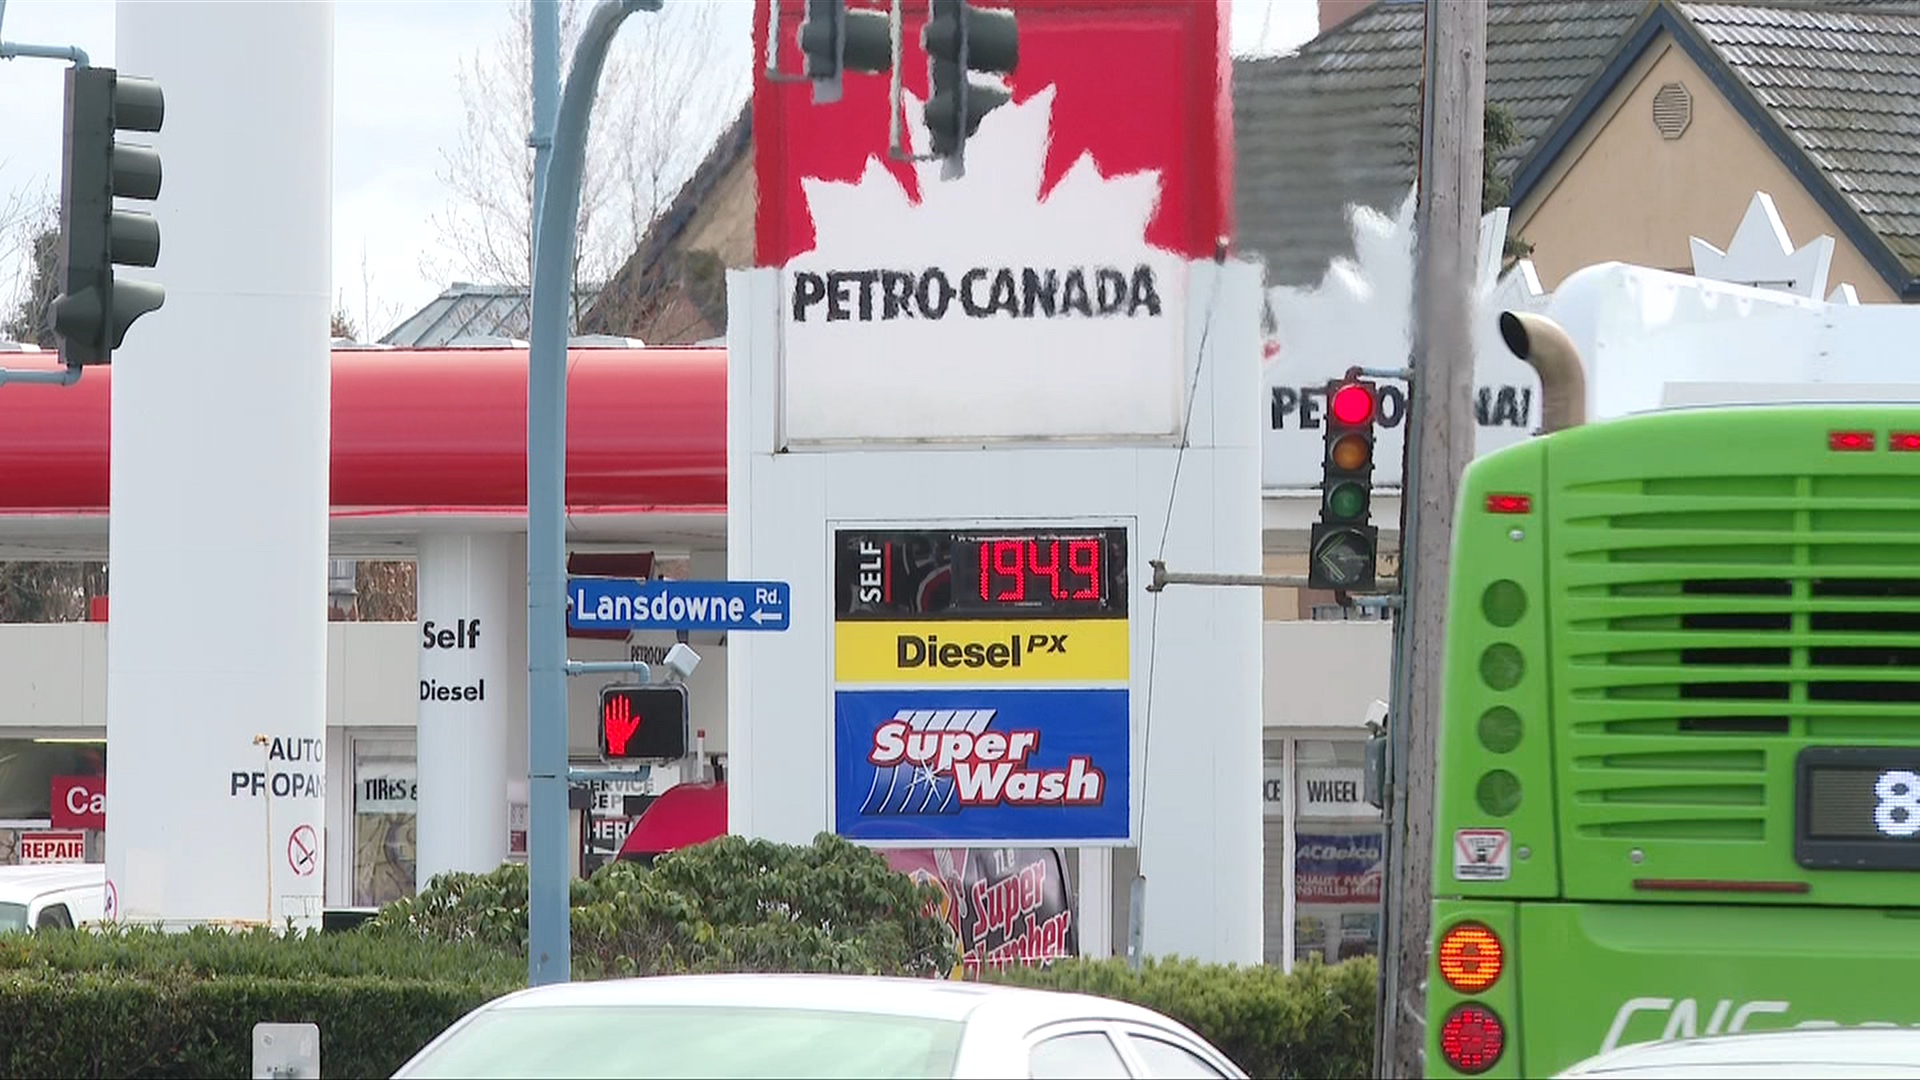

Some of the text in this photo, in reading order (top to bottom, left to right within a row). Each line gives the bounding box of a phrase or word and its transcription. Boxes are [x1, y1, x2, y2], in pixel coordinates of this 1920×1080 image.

[860, 541, 881, 604] SELF
[979, 539, 1100, 601] 194.9
[577, 588, 782, 622] Lansdowne Rd.
[423, 619, 481, 649] Self
[897, 635, 1068, 668] Diesel PX
[420, 679, 485, 700] Diesel
[269, 737, 323, 762] AUTO
[872, 723, 1035, 769] Super
[231, 772, 325, 798] PROPAN
[364, 778, 407, 800] TIRES
[955, 759, 1101, 801] Wash
[1307, 780, 1358, 802] WHEEL
[21, 842, 83, 858] REPAIR
[972, 860, 1044, 940] Super
